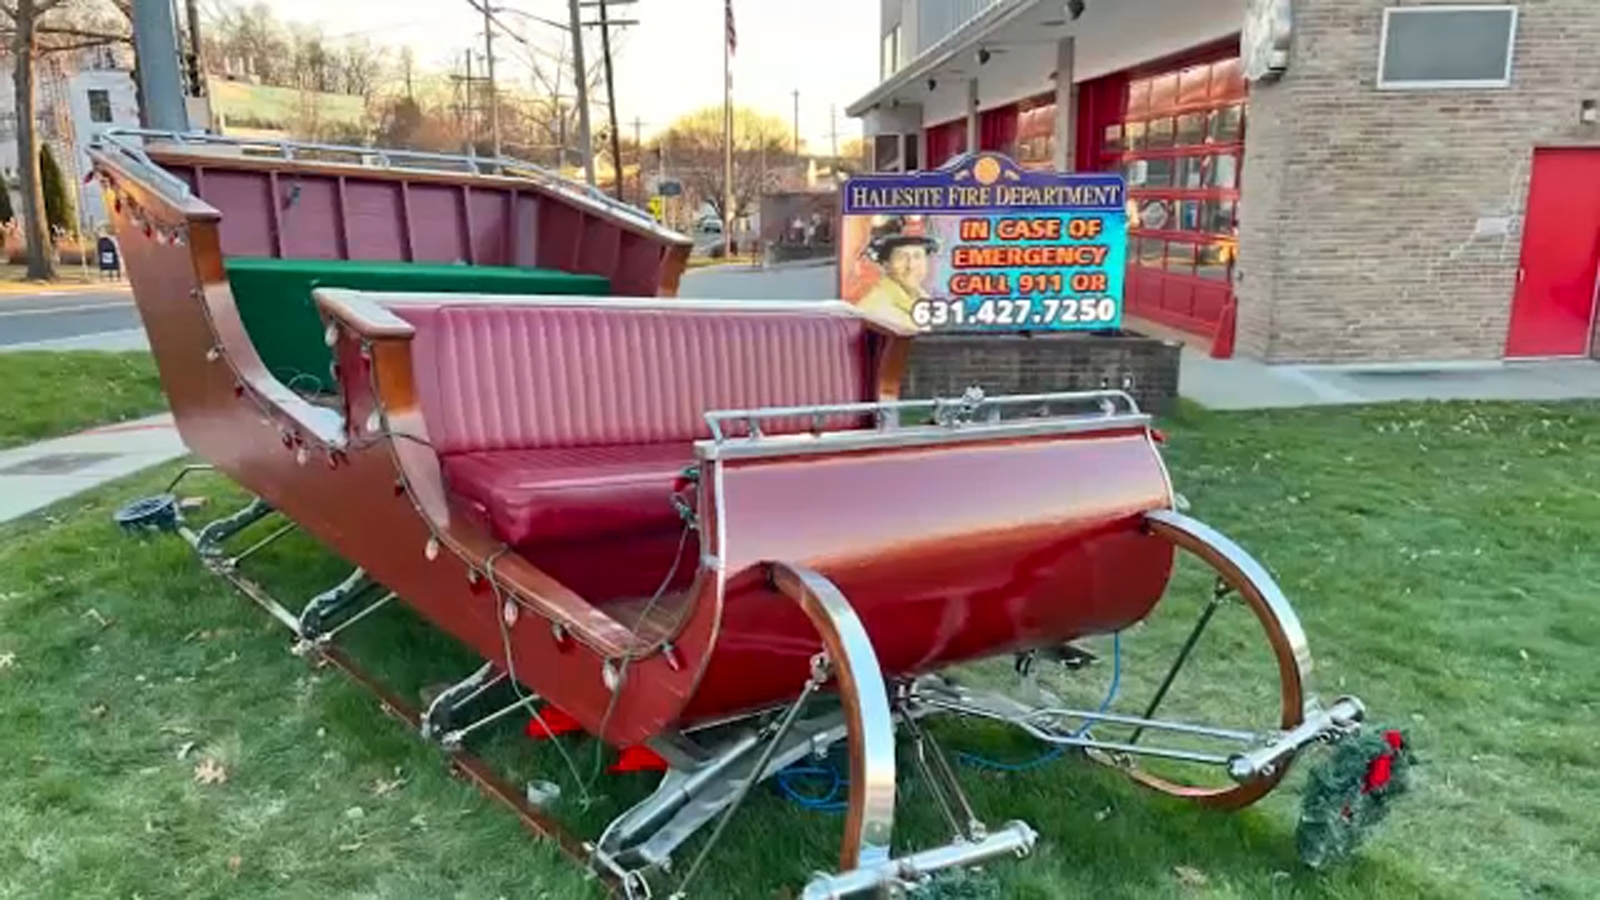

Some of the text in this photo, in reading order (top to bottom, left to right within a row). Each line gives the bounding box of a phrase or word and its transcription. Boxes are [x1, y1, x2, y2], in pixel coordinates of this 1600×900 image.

[853, 185, 1121, 208] HALESITE FIRE DEPARTMENT
[961, 219, 1101, 240] IN CASE OF
[953, 246, 1108, 267] EMERGENCY
[951, 274, 1106, 295] CALL 911 OR
[912, 299, 1116, 325] 631.427.7250
